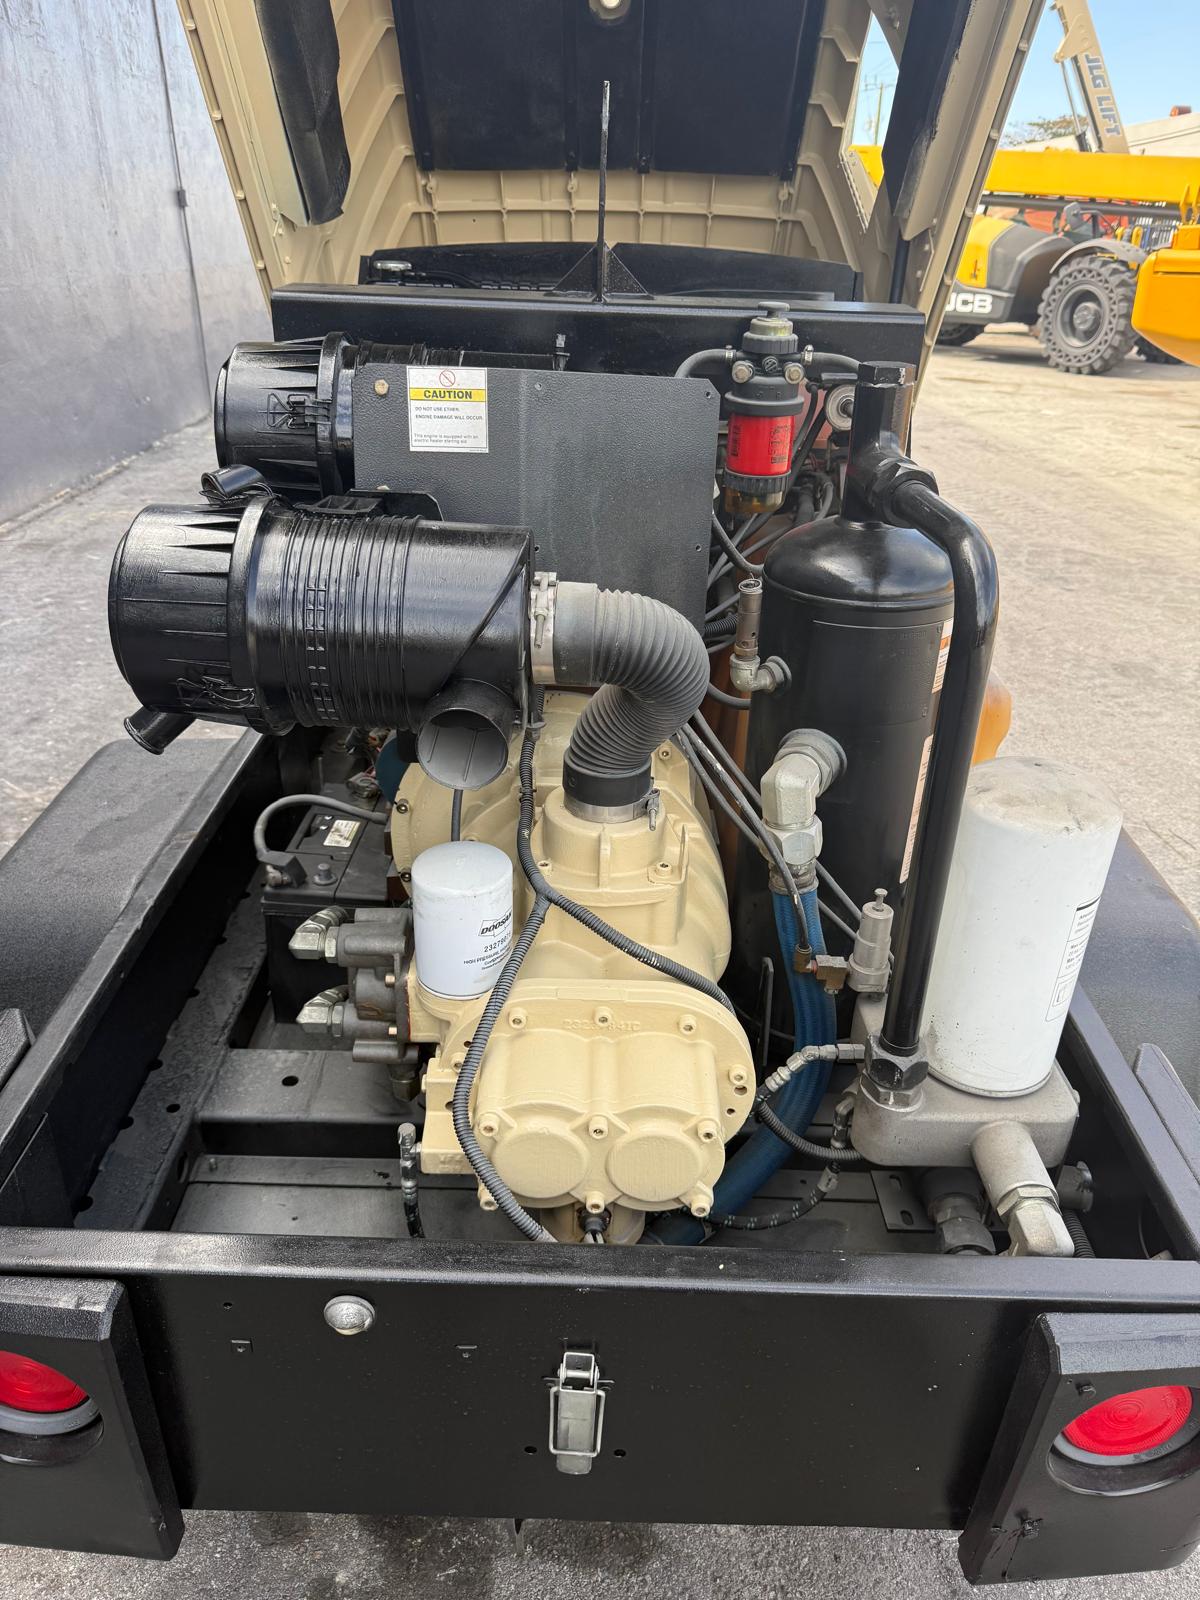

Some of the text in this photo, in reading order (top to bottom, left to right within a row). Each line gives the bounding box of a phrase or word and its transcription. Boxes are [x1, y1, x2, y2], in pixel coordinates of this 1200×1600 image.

[1085, 53, 1121, 136] JLG LIFT
[945, 292, 993, 314] JCB
[423, 390, 472, 399] CAUTION
